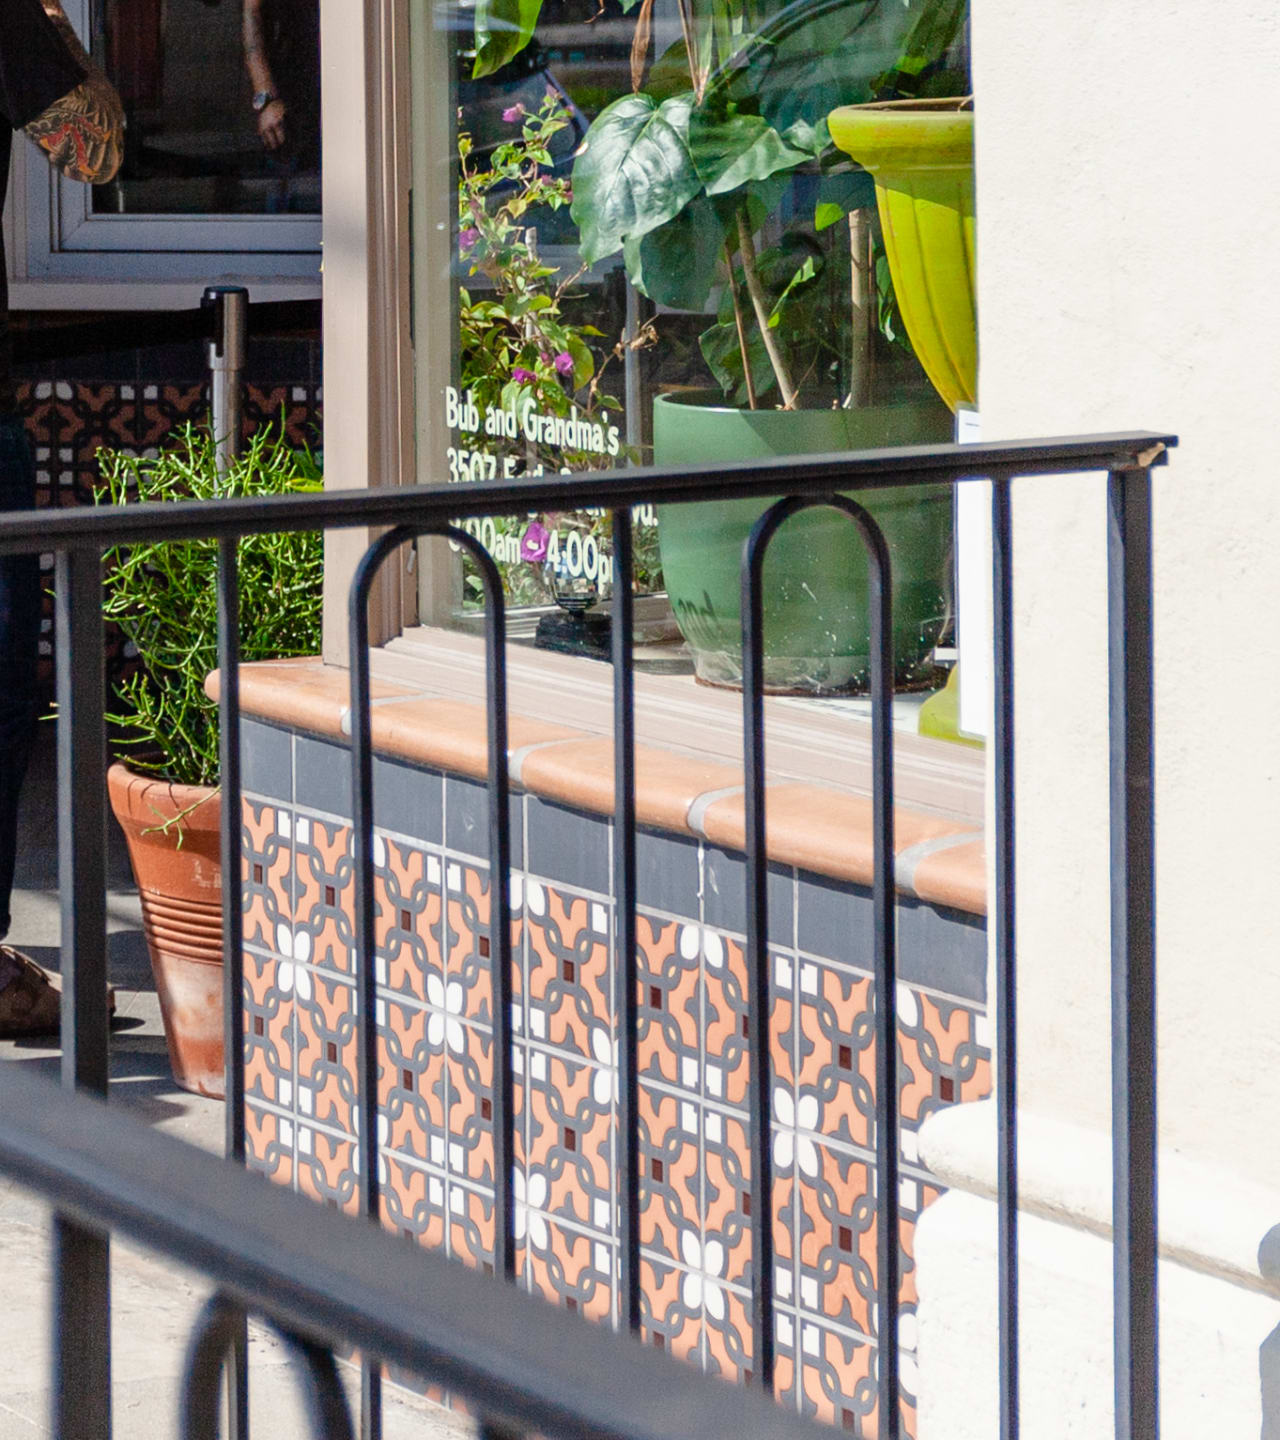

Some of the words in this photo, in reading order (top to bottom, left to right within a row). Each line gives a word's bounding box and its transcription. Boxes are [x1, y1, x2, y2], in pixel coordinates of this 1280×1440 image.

[446, 386, 479, 433] Bub
[485, 397, 517, 438] and
[523, 397, 620, 456] Grandma's
